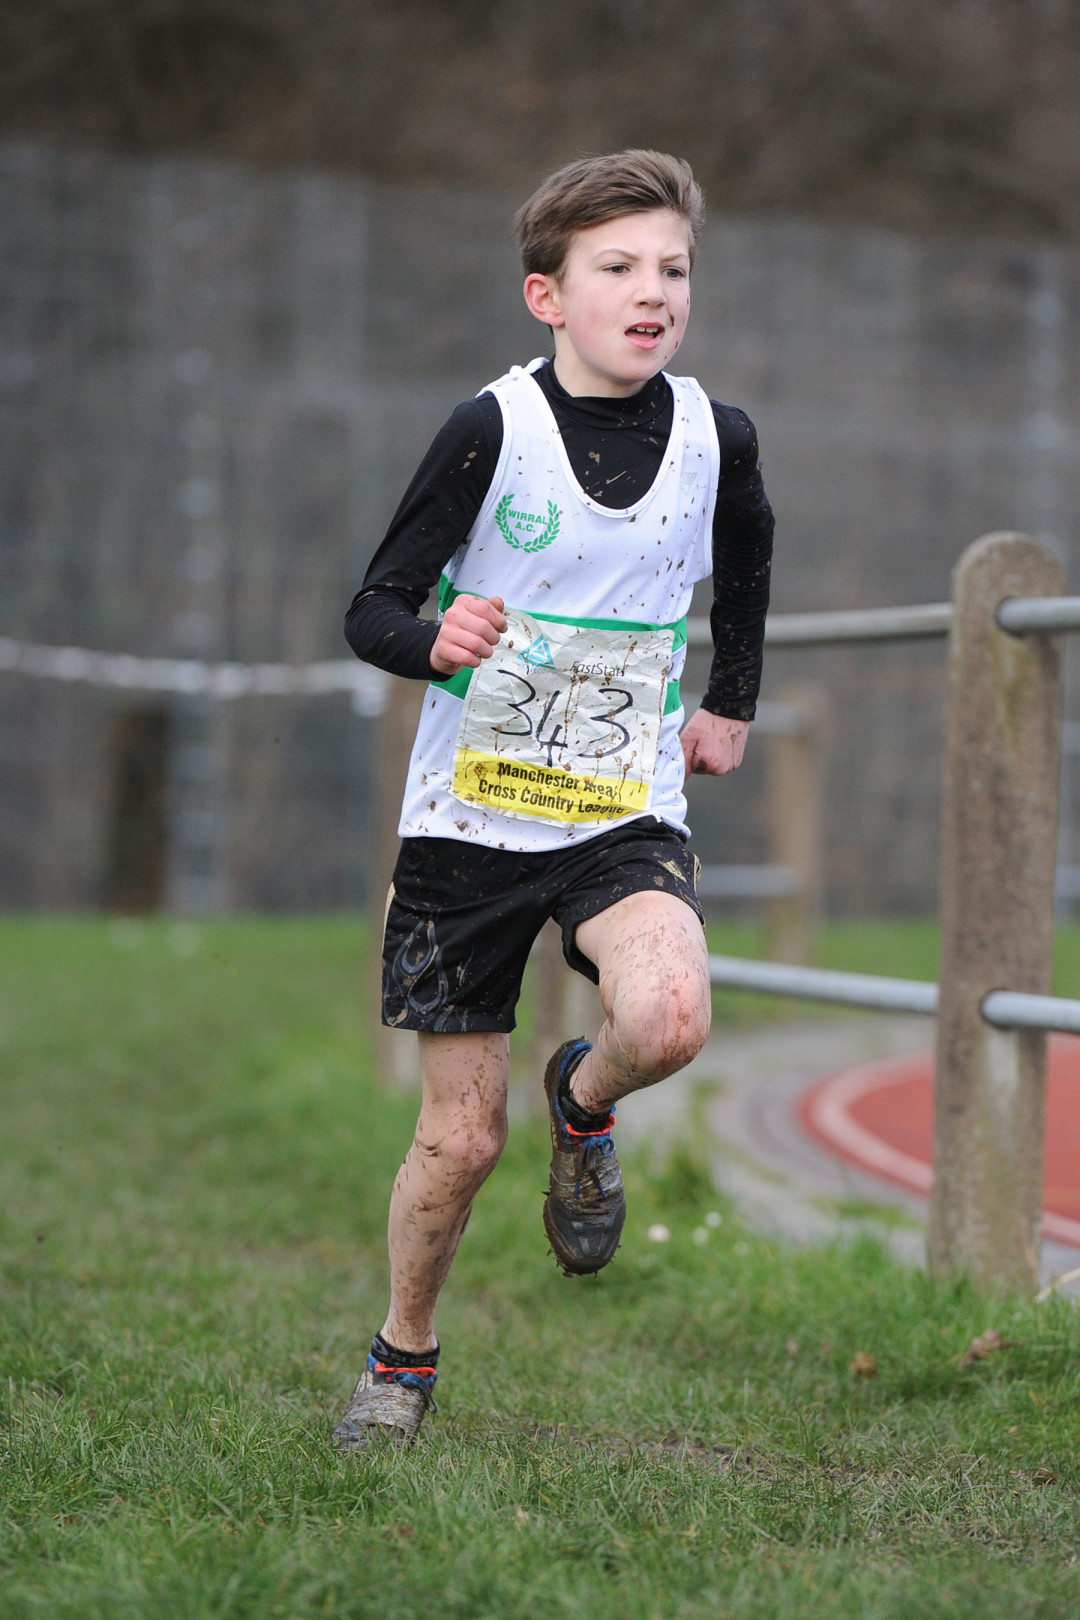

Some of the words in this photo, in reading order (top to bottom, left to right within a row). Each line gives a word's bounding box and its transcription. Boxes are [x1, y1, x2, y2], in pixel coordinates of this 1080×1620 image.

[508, 509, 547, 525] WIRRAL
[515, 521, 535, 533] A.C.
[490, 669, 633, 767] 343
[478, 778, 517, 801] Cross
[520, 785, 575, 814] Country
[578, 799, 625, 814] League
[498, 761, 580, 790] Manchester
[584, 780, 613, 798] Area
